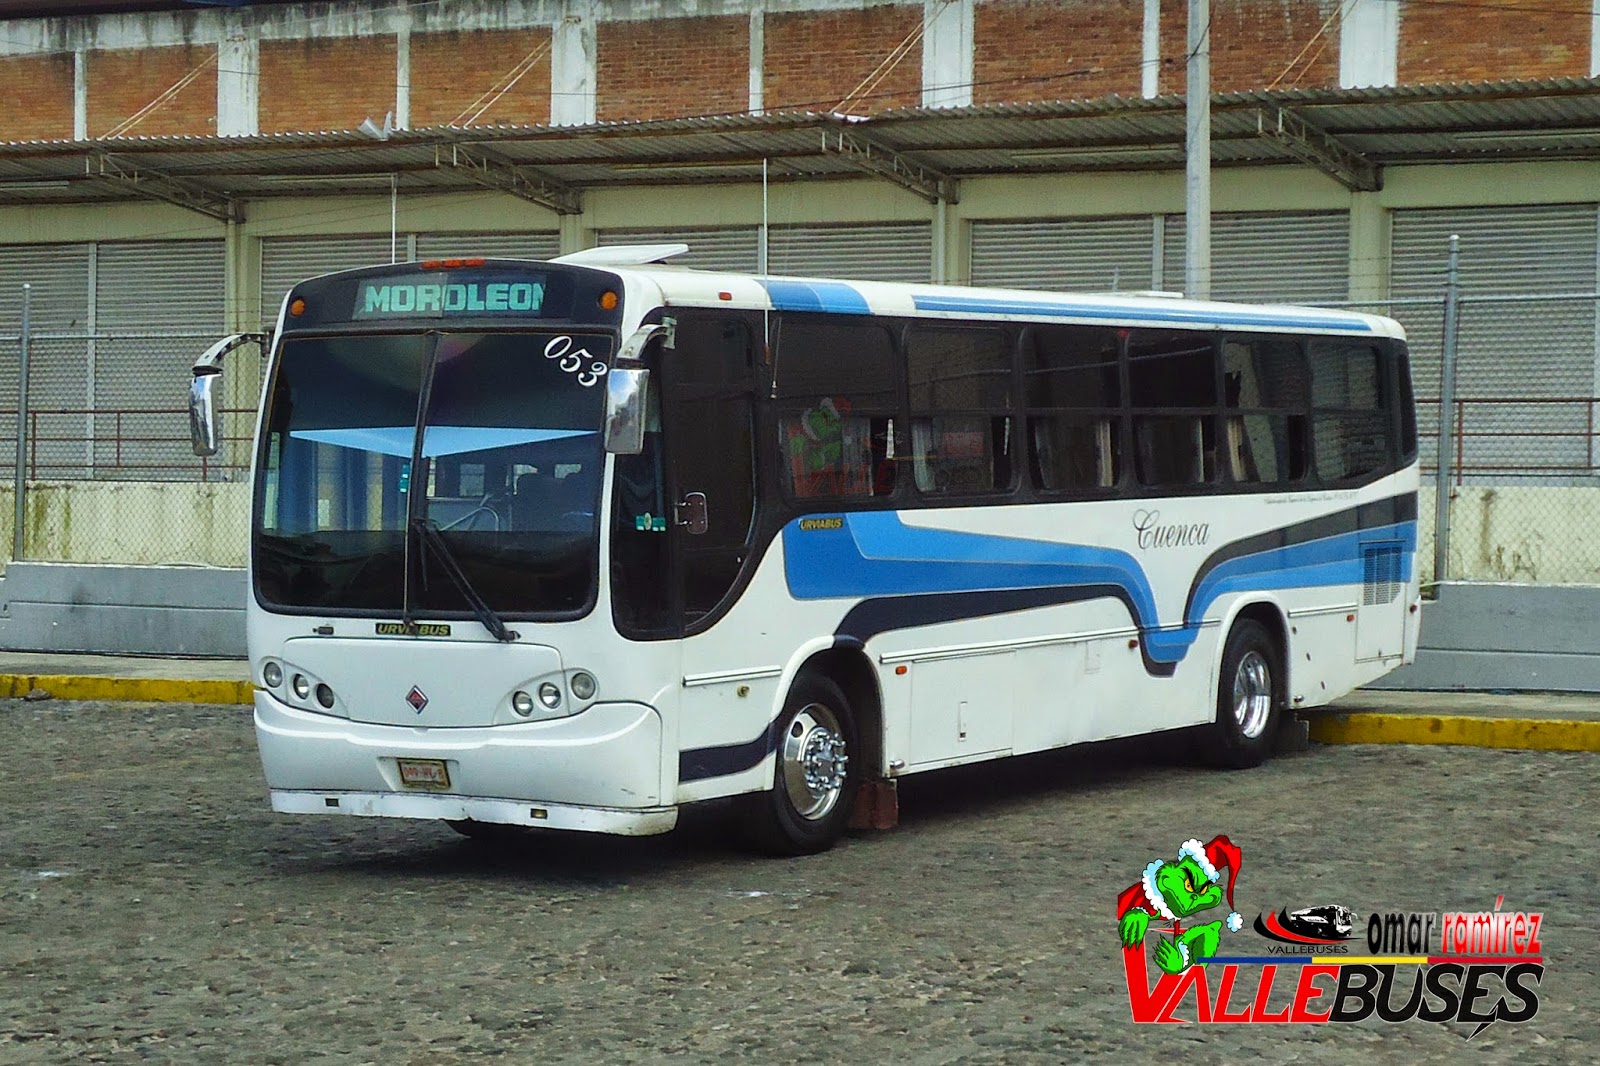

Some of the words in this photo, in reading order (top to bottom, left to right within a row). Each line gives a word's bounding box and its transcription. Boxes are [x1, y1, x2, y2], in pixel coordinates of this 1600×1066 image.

[543, 335, 608, 387] 053
[1132, 508, 1210, 550] Cuenca
[377, 623, 449, 636] URVIBUS
